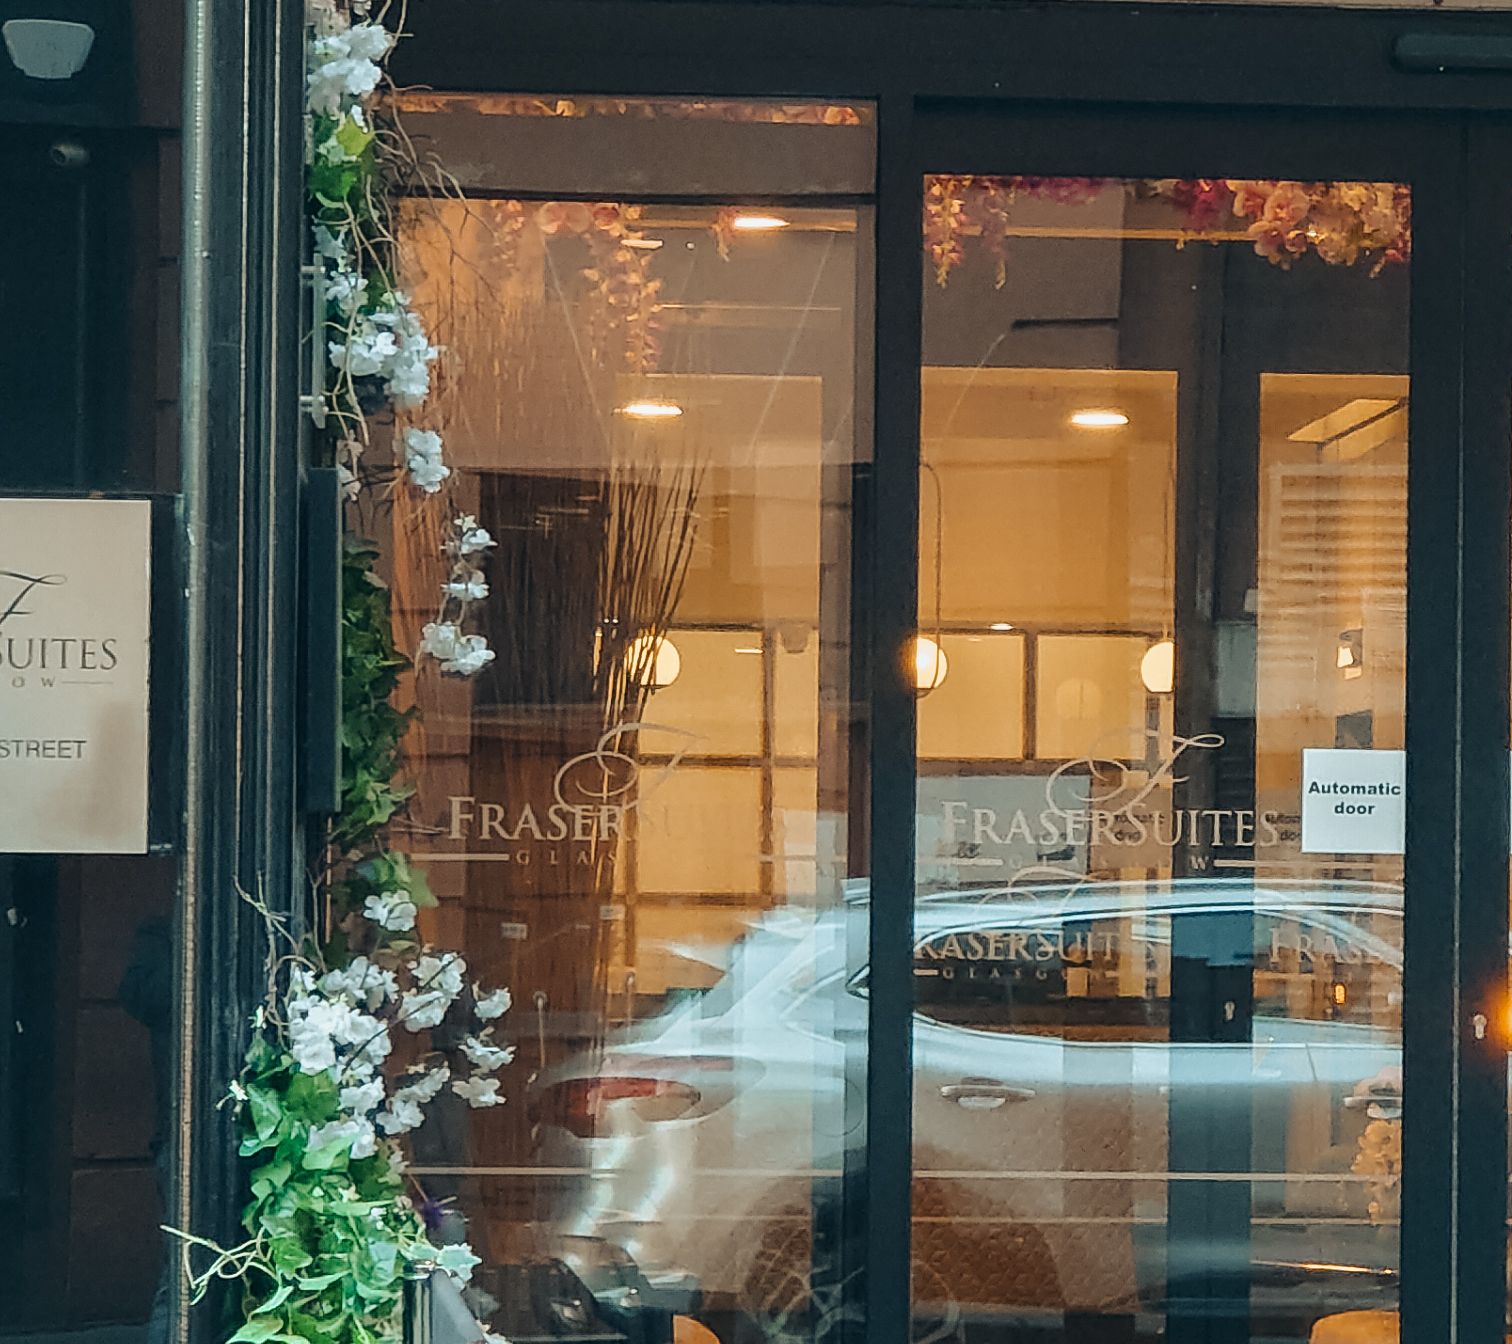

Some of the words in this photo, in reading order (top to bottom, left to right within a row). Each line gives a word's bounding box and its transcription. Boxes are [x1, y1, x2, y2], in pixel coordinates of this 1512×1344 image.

[0, 631, 118, 670] UITES
[0, 739, 88, 759] STREET
[1308, 780, 1401, 796] Automatic
[1333, 801, 1375, 816] door
[940, 800, 1278, 848] FRASERSUITES
